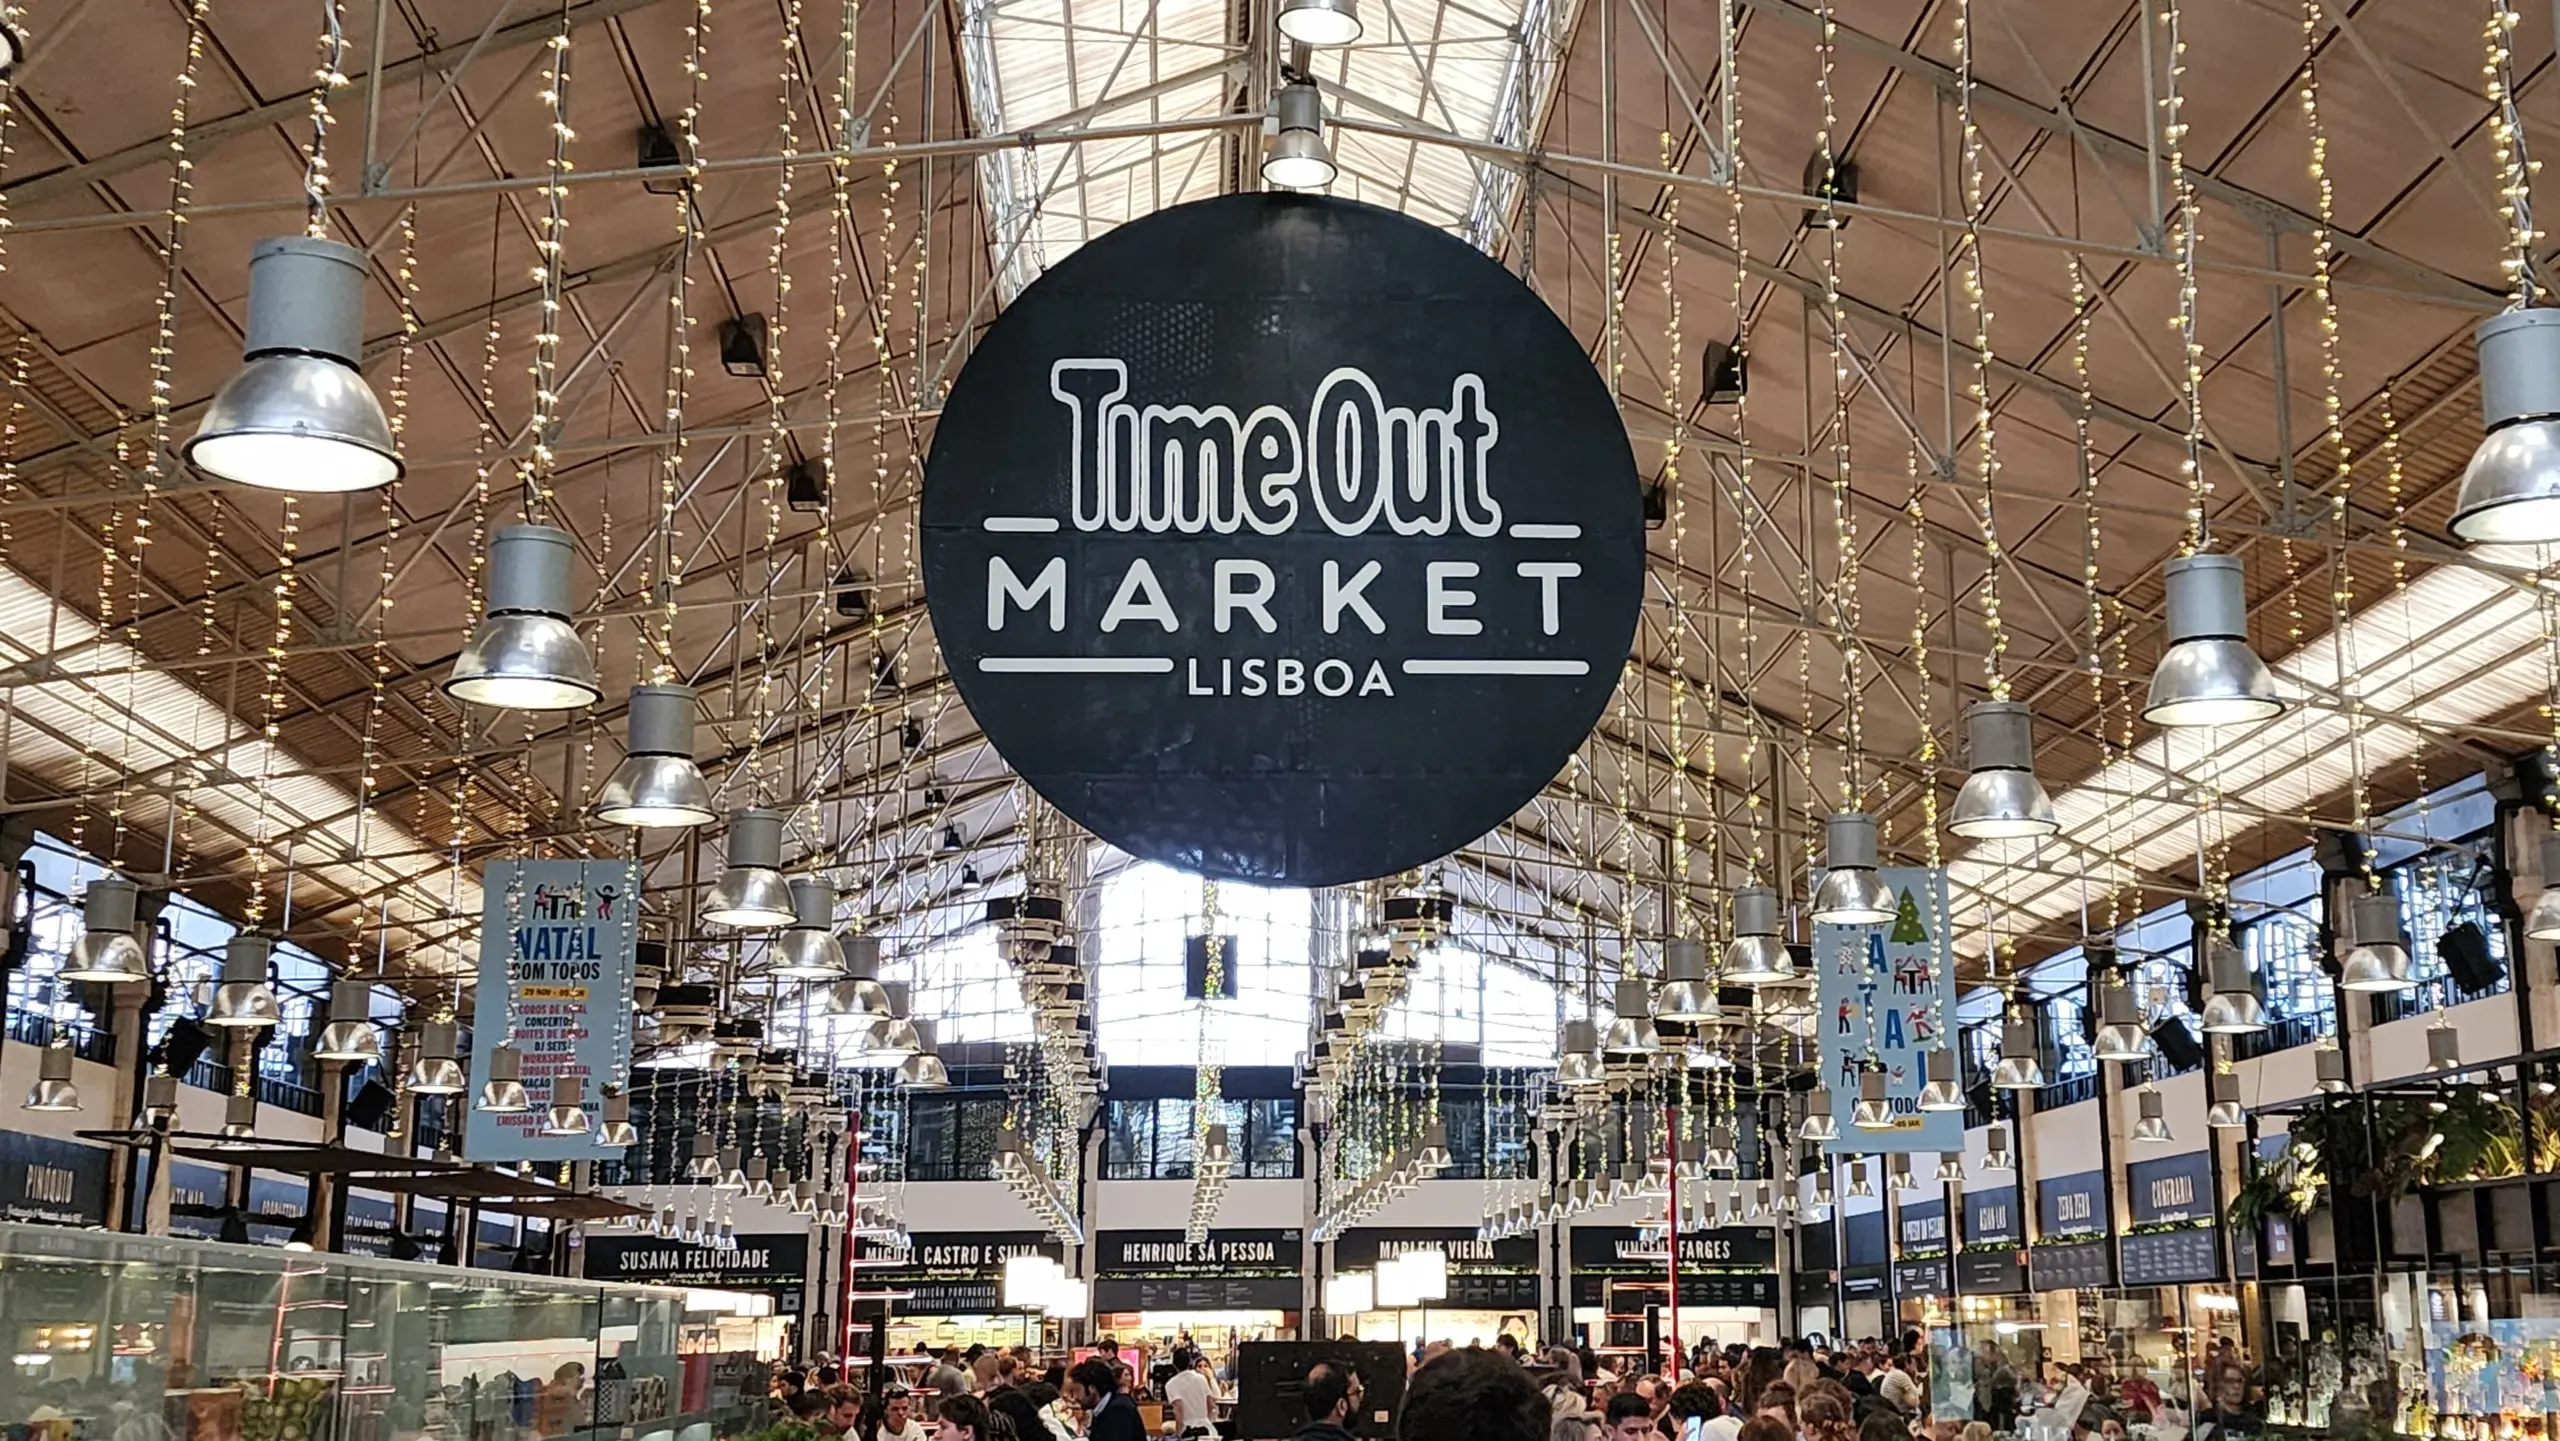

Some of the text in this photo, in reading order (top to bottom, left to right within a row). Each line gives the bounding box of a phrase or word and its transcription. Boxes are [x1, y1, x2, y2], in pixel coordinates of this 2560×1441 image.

[1049, 357, 1503, 538] Time Out
[986, 555, 1583, 637] MARKET
[1187, 657, 1395, 698] LISBOA
[514, 927, 602, 961] NATAL
[513, 961, 601, 981] COM TODOS
[536, 988, 552, 997] NOV
[549, 1004, 560, 1014] DE
[547, 1029, 560, 1039] DE
[547, 1041, 568, 1052] SETS
[522, 1053, 576, 1064] WORKSHO
[1886, 1096, 1932, 1114] TODO
[619, 1249, 770, 1271] SUSANA FELICIDADE
[923, 1245, 980, 1265] CASTRO
[984, 1244, 993, 1264] E
[1123, 1239, 1275, 1263] HENRIQUE SÁ PESSOA
[1447, 1239, 1495, 1260] VIEIRA
[1614, 1239, 1731, 1260] VINCEN FARGES
